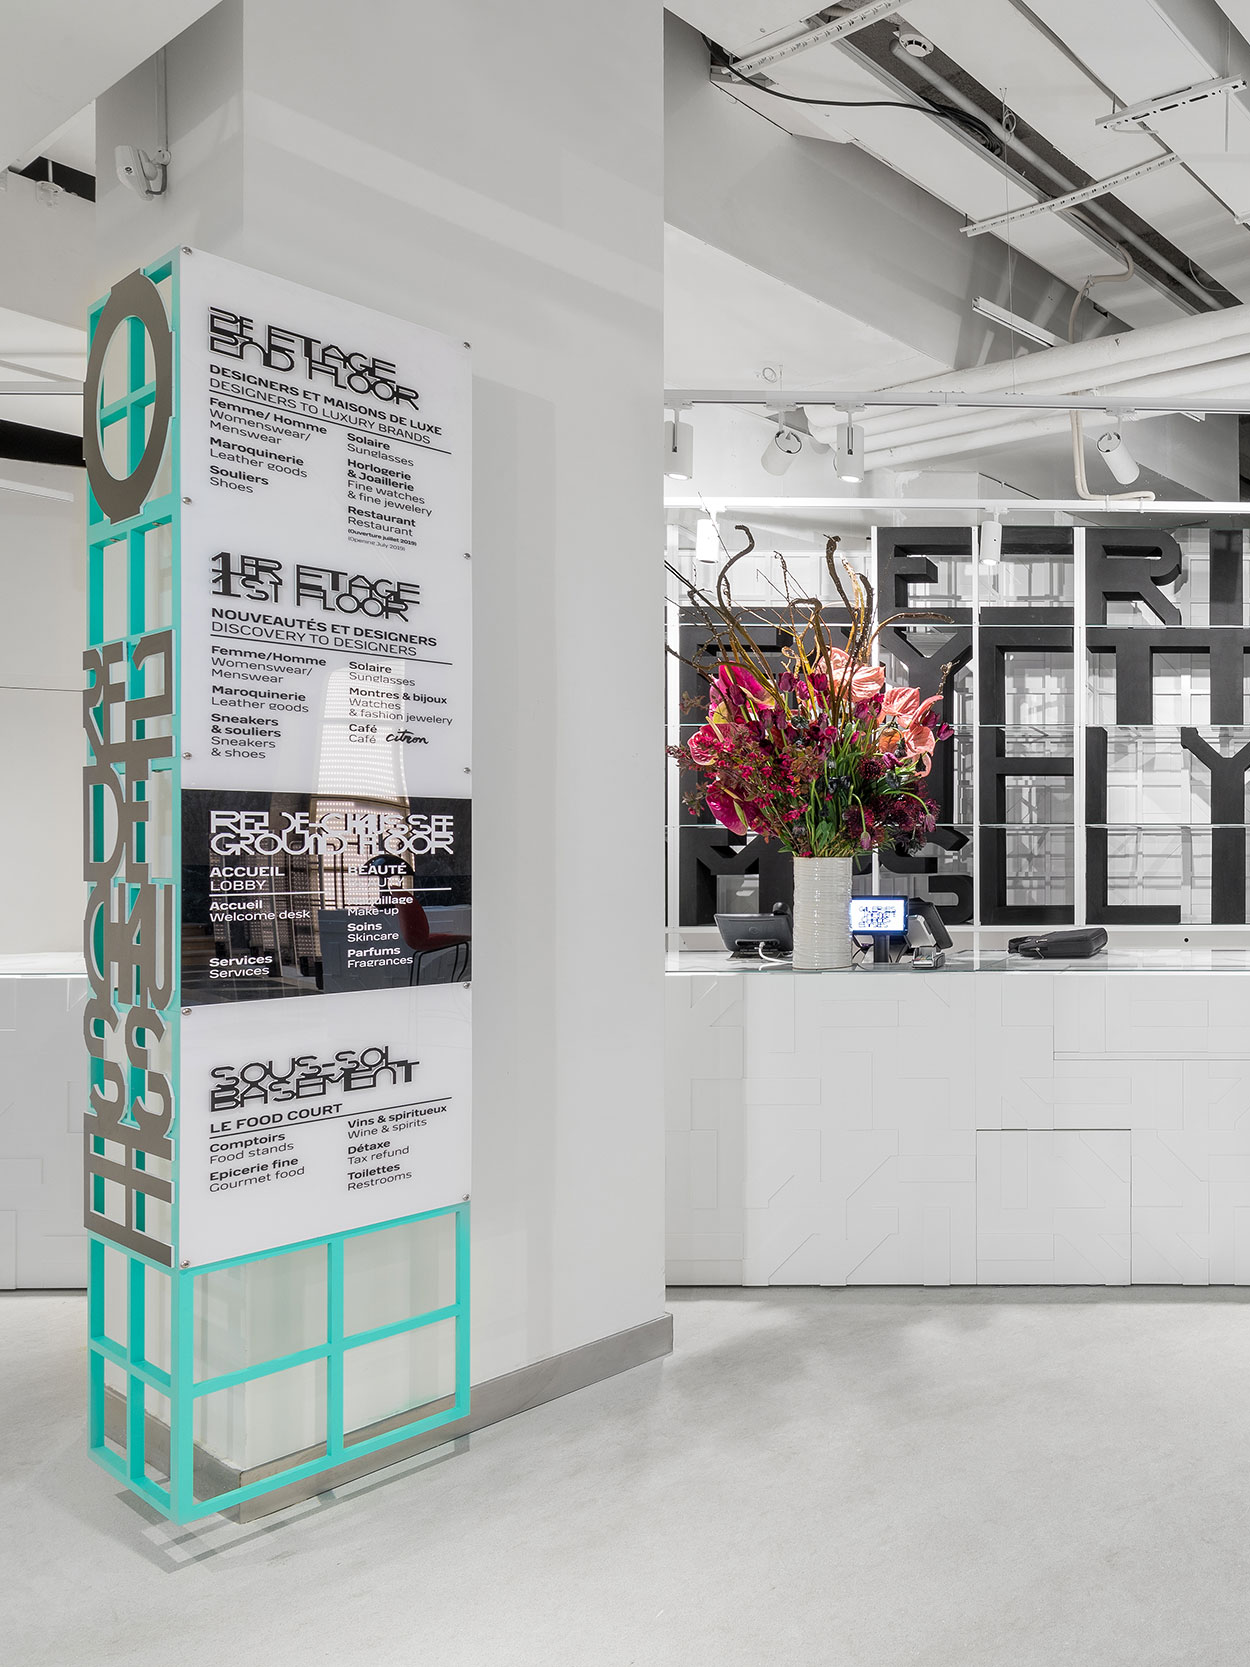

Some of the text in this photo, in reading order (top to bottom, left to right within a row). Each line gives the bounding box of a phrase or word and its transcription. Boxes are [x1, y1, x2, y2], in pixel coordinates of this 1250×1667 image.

[306, 358, 420, 411] FLOOR
[209, 364, 443, 436] DESIGNERS ET MAISONS DE LUXE
[209, 378, 431, 444] DESIGNERS TO LUXURY BRANDS
[209, 397, 328, 434] Femme/ Homme
[209, 408, 311, 441] Womenswear/
[209, 420, 282, 444] Menswear
[347, 432, 391, 450] Solaire
[209, 436, 304, 466] Maroquinerie
[347, 443, 414, 467] Sunglasses
[210, 448, 308, 478] Leather goods
[347, 458, 412, 480] Horlogerie
[209, 465, 269, 485] Souliers
[347, 469, 415, 491] & Joaillerie
[209, 476, 254, 493] Shoes
[347, 479, 425, 504] Fine watches
[347, 490, 433, 517] & fine jewelery
[347, 505, 417, 527] Restaurant
[347, 516, 413, 537] Restaurant
[296, 583, 409, 622] FLOOR
[211, 606, 438, 647] NOUVEAUTÉS ET DESIGNERS
[211, 621, 417, 656] DISCOVERY TO DESIGNERS
[211, 645, 327, 666] Femme/Homme
[211, 656, 313, 676] Womenswear/
[348, 661, 392, 673] Solaire
[211, 668, 284, 683] Menswear
[349, 671, 416, 686] Sunglasses
[212, 684, 306, 701] Maroquinerie
[349, 687, 448, 704] Montres & bijoux
[211, 696, 309, 713] Leather goods
[349, 697, 402, 710] Watches
[211, 713, 279, 726] Sneakers
[348, 708, 453, 726] & fashion jewelery
[211, 724, 281, 738] & souliers
[348, 723, 378, 733] Café
[385, 728, 430, 745] citron
[211, 736, 276, 748] Sneakers
[348, 734, 377, 744] Café
[211, 747, 266, 759] & shoes
[209, 866, 286, 878] ACCUEIL
[347, 864, 408, 876] BEAUTÉ
[210, 879, 267, 891] LOBBY
[209, 899, 263, 911] Accueil
[347, 906, 399, 918] Make-up
[209, 909, 311, 923] Welcome desk
[347, 922, 383, 932] Soins
[347, 932, 400, 943] Skincare
[209, 955, 273, 967] Services
[347, 946, 401, 959] Parfums
[347, 956, 414, 969] Fragrances
[209, 966, 270, 979] Services
[209, 1103, 343, 1134] LE FOOD COURT
[347, 1105, 448, 1129] Vins & spiritueux
[347, 1118, 427, 1139] Wine & spirits
[209, 1132, 286, 1153] Comptoirs
[348, 1139, 391, 1154] Détaxe
[209, 1141, 295, 1164] Food stands
[347, 1146, 410, 1165] Tax refund
[209, 1157, 299, 1182] Epicerie fine
[347, 1163, 401, 1180] Toilettes
[209, 1166, 305, 1193] Gourmet food
[347, 1171, 413, 1191] Restrooms
